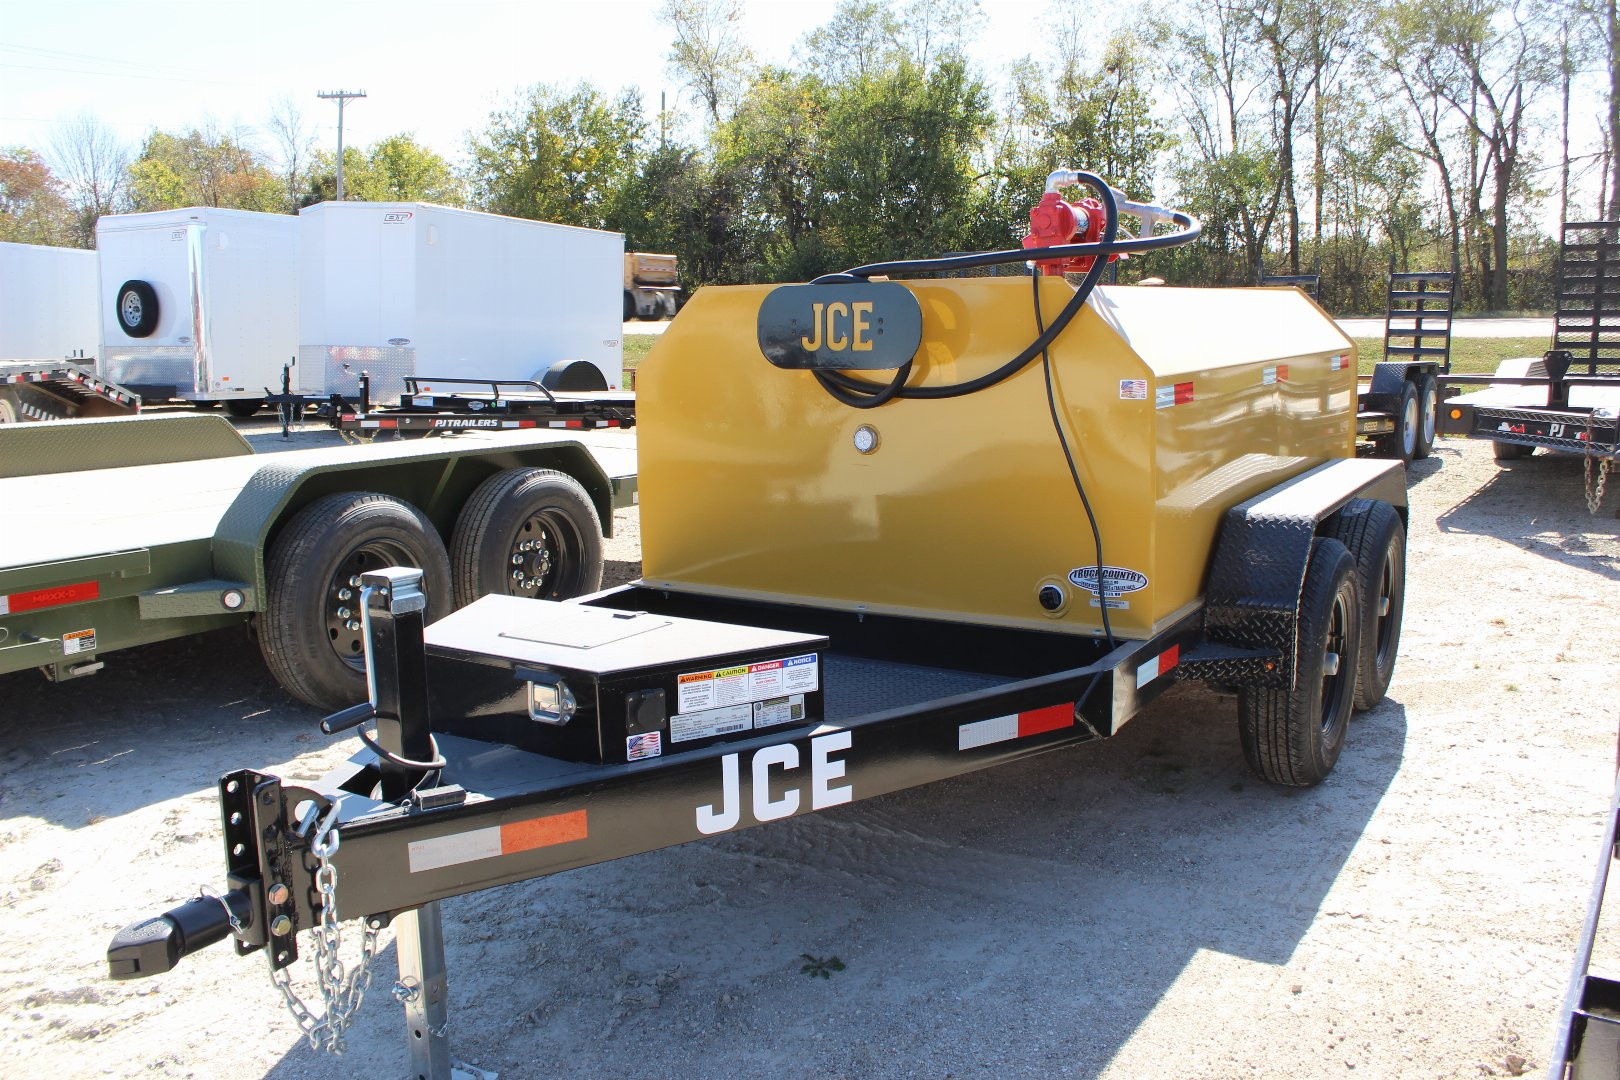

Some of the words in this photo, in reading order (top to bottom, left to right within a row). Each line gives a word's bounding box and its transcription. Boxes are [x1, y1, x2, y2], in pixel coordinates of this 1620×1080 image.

[801, 301, 873, 352] JCE
[447, 419, 498, 427] TRAILERS
[1549, 423, 1566, 438] PJ
[1102, 569, 1144, 582] COUNTRY
[32, 589, 77, 603] MAXX-D
[757, 662, 780, 671] DANGER
[793, 657, 812, 665] NOTICE
[721, 667, 747, 677] CAUTION
[685, 673, 713, 683] WARNING
[695, 730, 853, 835] JCE
